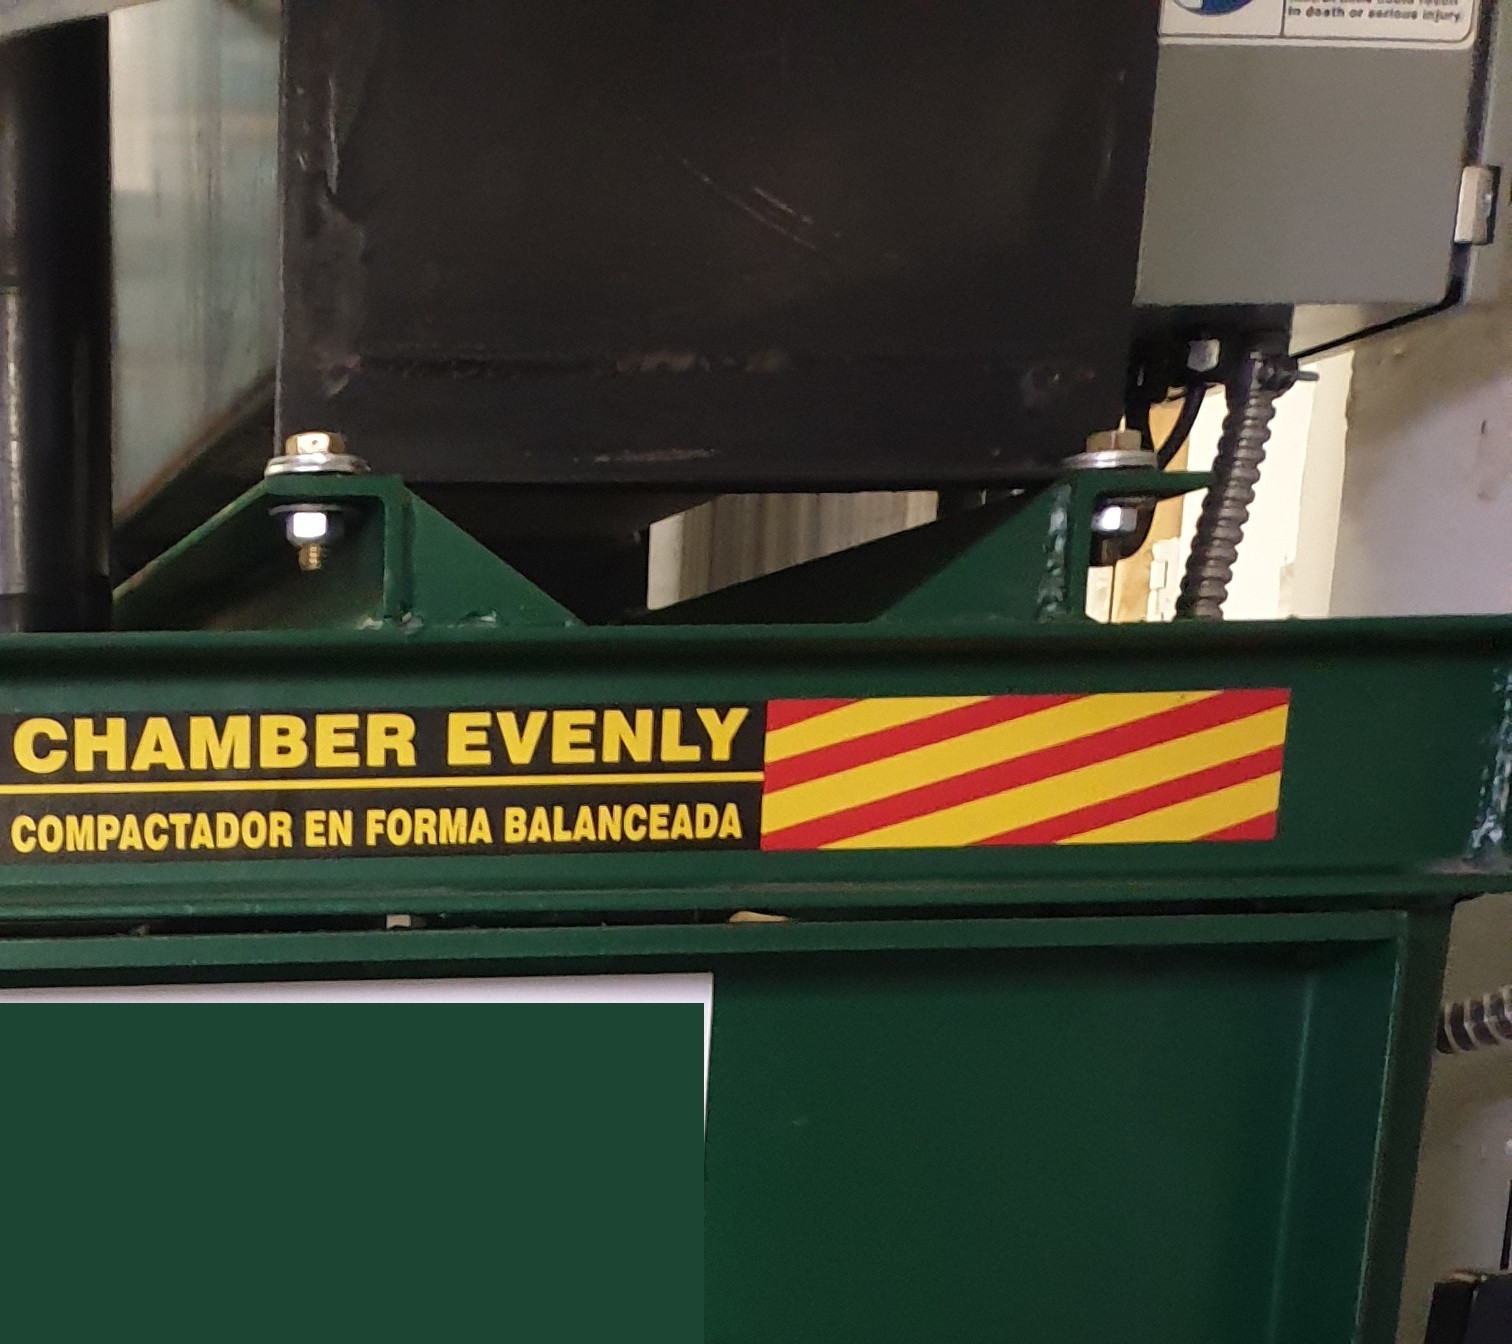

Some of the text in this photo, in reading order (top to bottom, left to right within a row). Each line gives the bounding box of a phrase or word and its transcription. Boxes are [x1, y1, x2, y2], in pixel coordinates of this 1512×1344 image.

[1306, 6, 1344, 18] death
[1349, 9, 1363, 18] or
[1423, 11, 1460, 22] injury
[13, 713, 416, 774] CHAMBER
[447, 708, 748, 766] EVENLY
[11, 811, 291, 854] COMPACTADOR
[306, 810, 352, 847] EN
[366, 807, 491, 846] FORMA
[505, 803, 742, 843] BALANCEADA
